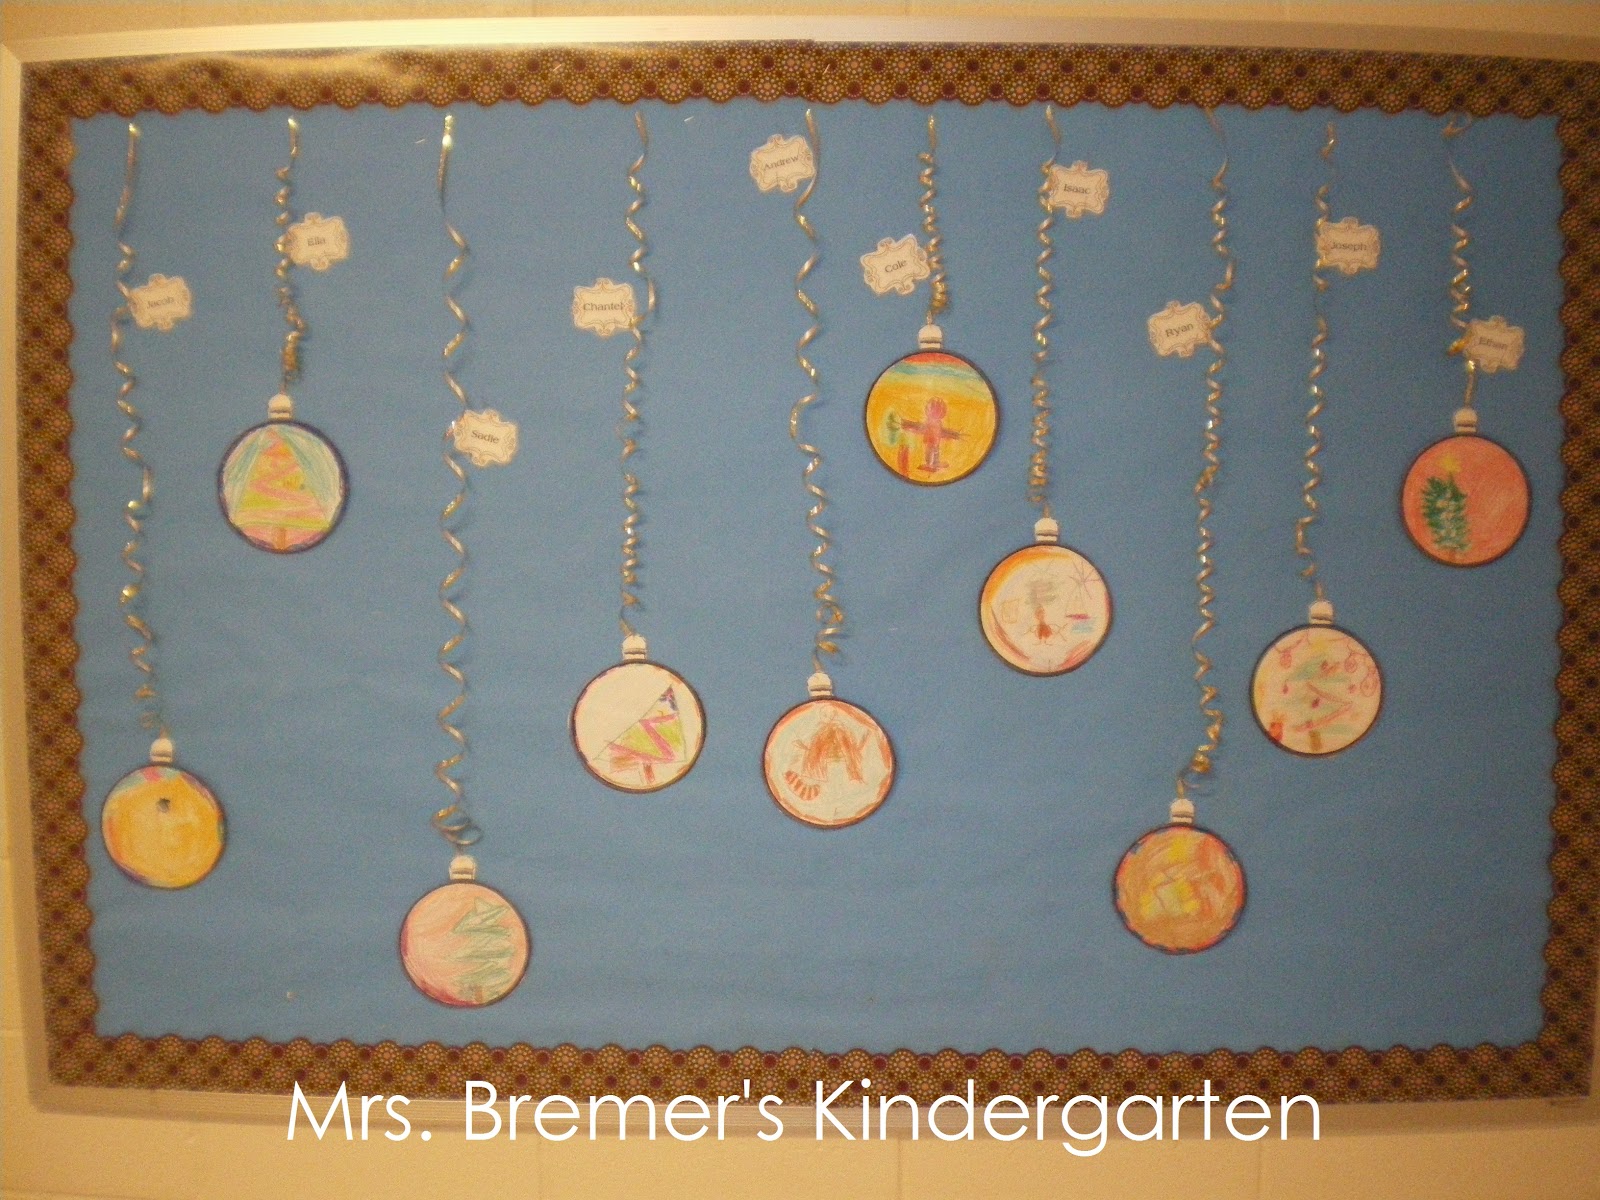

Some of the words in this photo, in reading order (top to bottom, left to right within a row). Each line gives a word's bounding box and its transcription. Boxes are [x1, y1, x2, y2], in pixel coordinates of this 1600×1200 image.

[764, 154, 800, 170] Andrew
[1063, 184, 1091, 195] Isaac
[307, 235, 326, 246] Ella
[1330, 241, 1367, 254] Joseph
[885, 258, 907, 273] Cole
[147, 295, 175, 309] Jacob
[583, 302, 625, 312] Chantel
[1165, 322, 1195, 338] Ryan
[471, 429, 500, 444] Sadie
